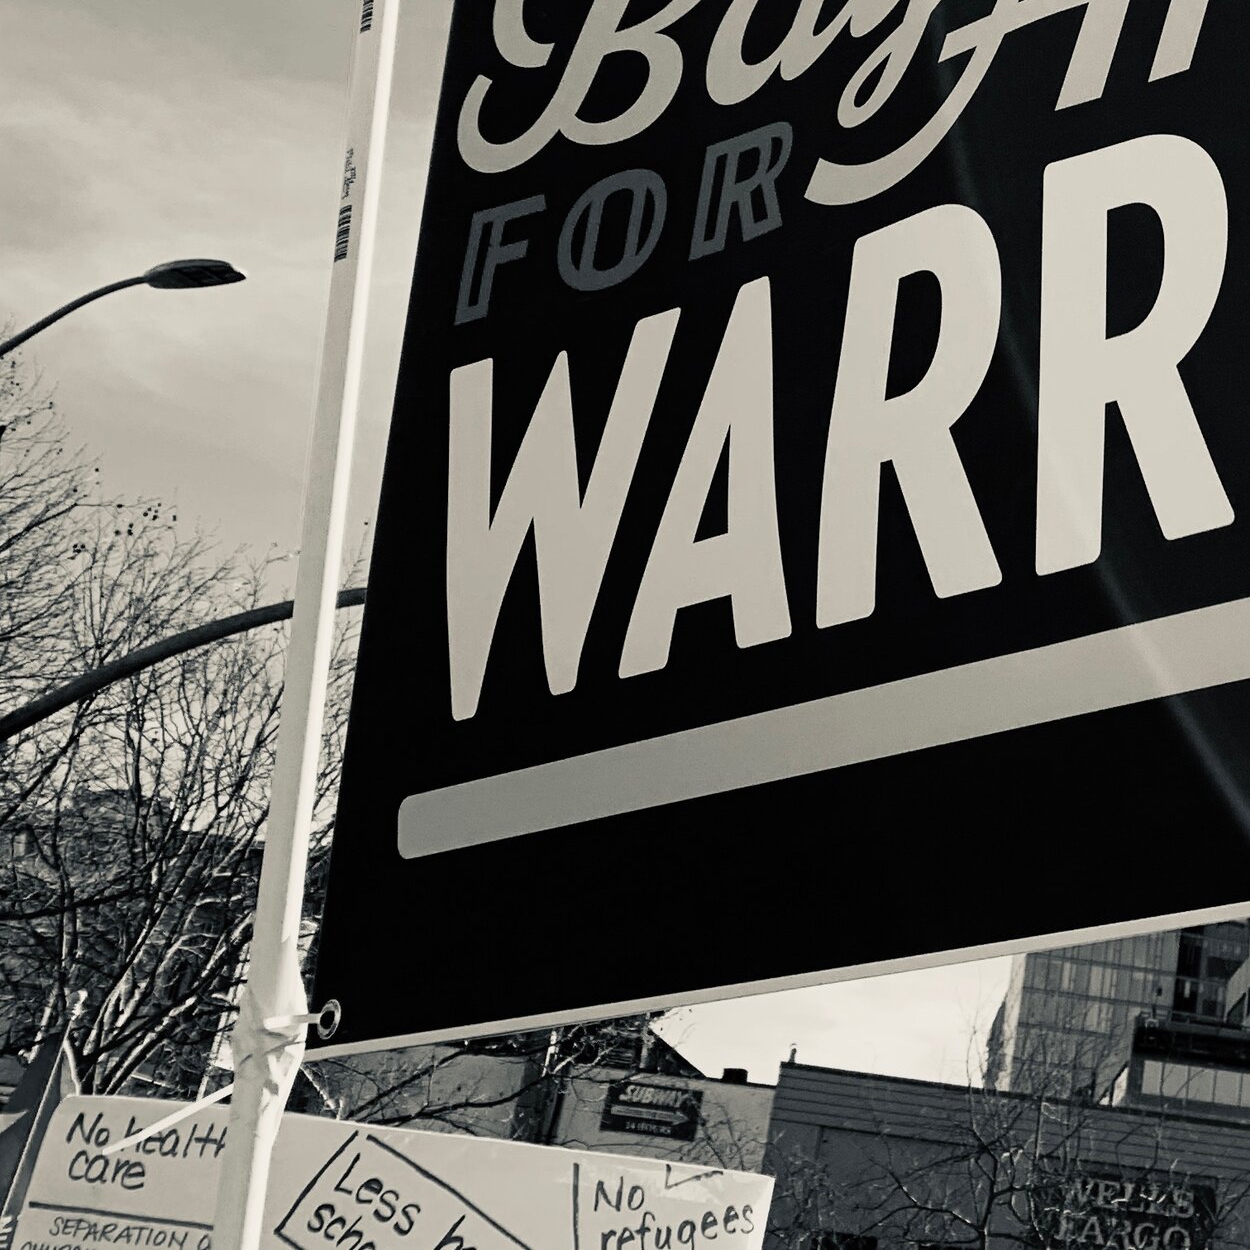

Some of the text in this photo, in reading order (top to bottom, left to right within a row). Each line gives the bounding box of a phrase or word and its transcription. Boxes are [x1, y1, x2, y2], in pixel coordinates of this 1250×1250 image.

[454, 122, 793, 325] FOR
[618, 1085, 689, 1108] SUBWAY
[66, 1112, 110, 1147] No
[69, 1150, 146, 1190] care
[334, 1152, 421, 1236] Less
[594, 1176, 644, 1211] No
[49, 1217, 188, 1249] SEPARATION
[601, 1204, 755, 1250] refugees
